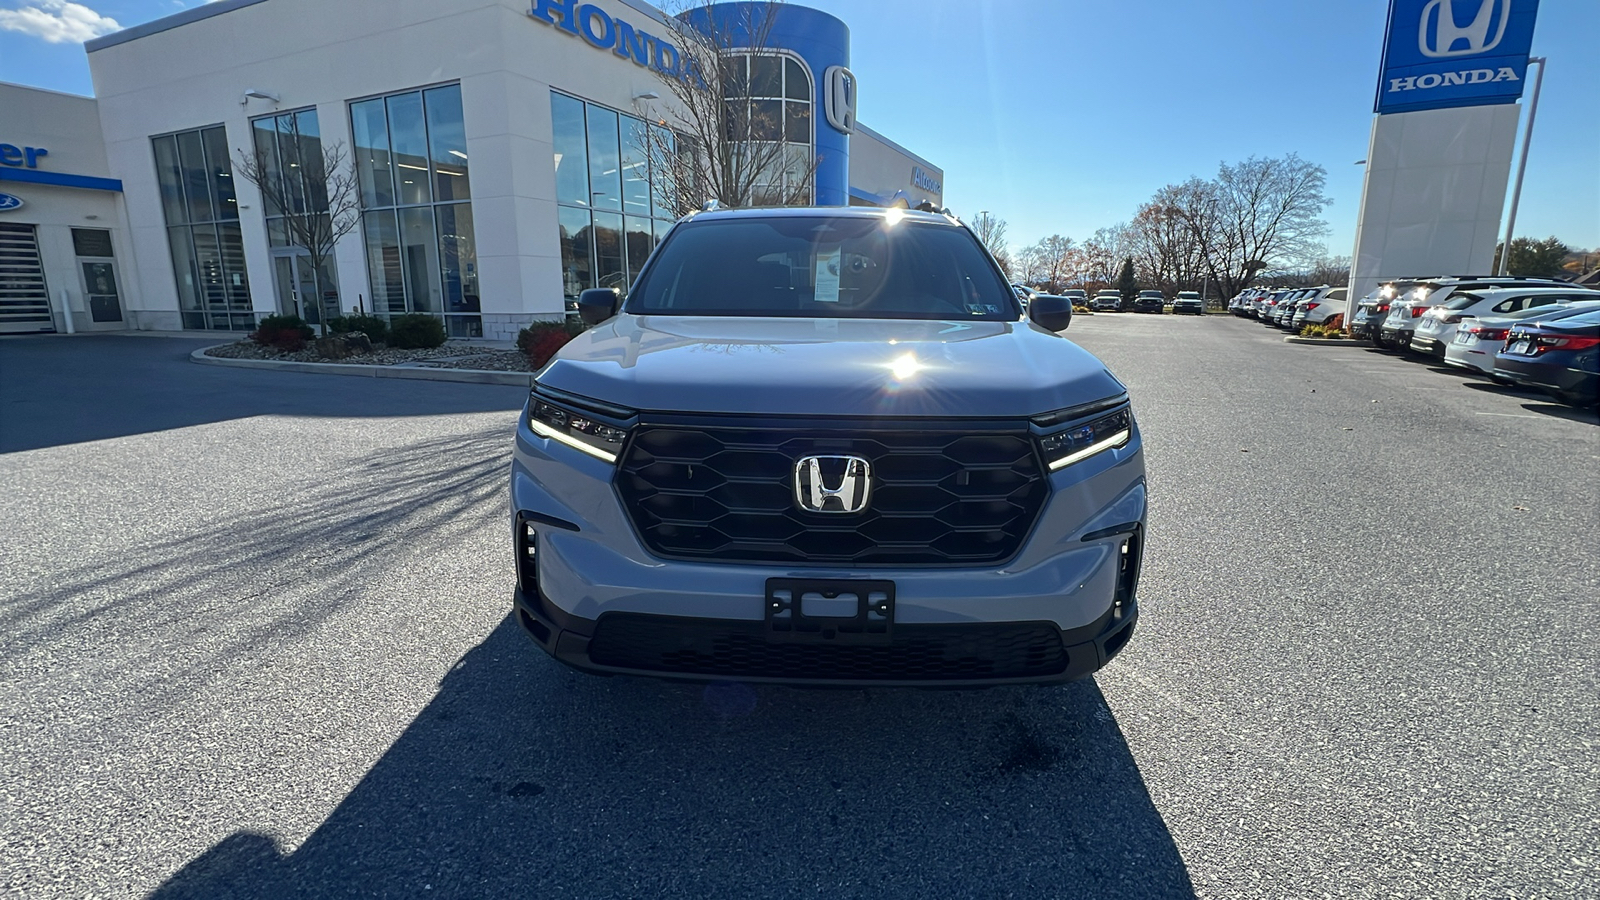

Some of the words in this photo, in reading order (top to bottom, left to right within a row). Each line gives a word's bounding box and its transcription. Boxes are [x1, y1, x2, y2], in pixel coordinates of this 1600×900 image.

[527, 0, 707, 91] HONDA
[1388, 67, 1519, 92] HONDA
[0, 143, 48, 168] er
